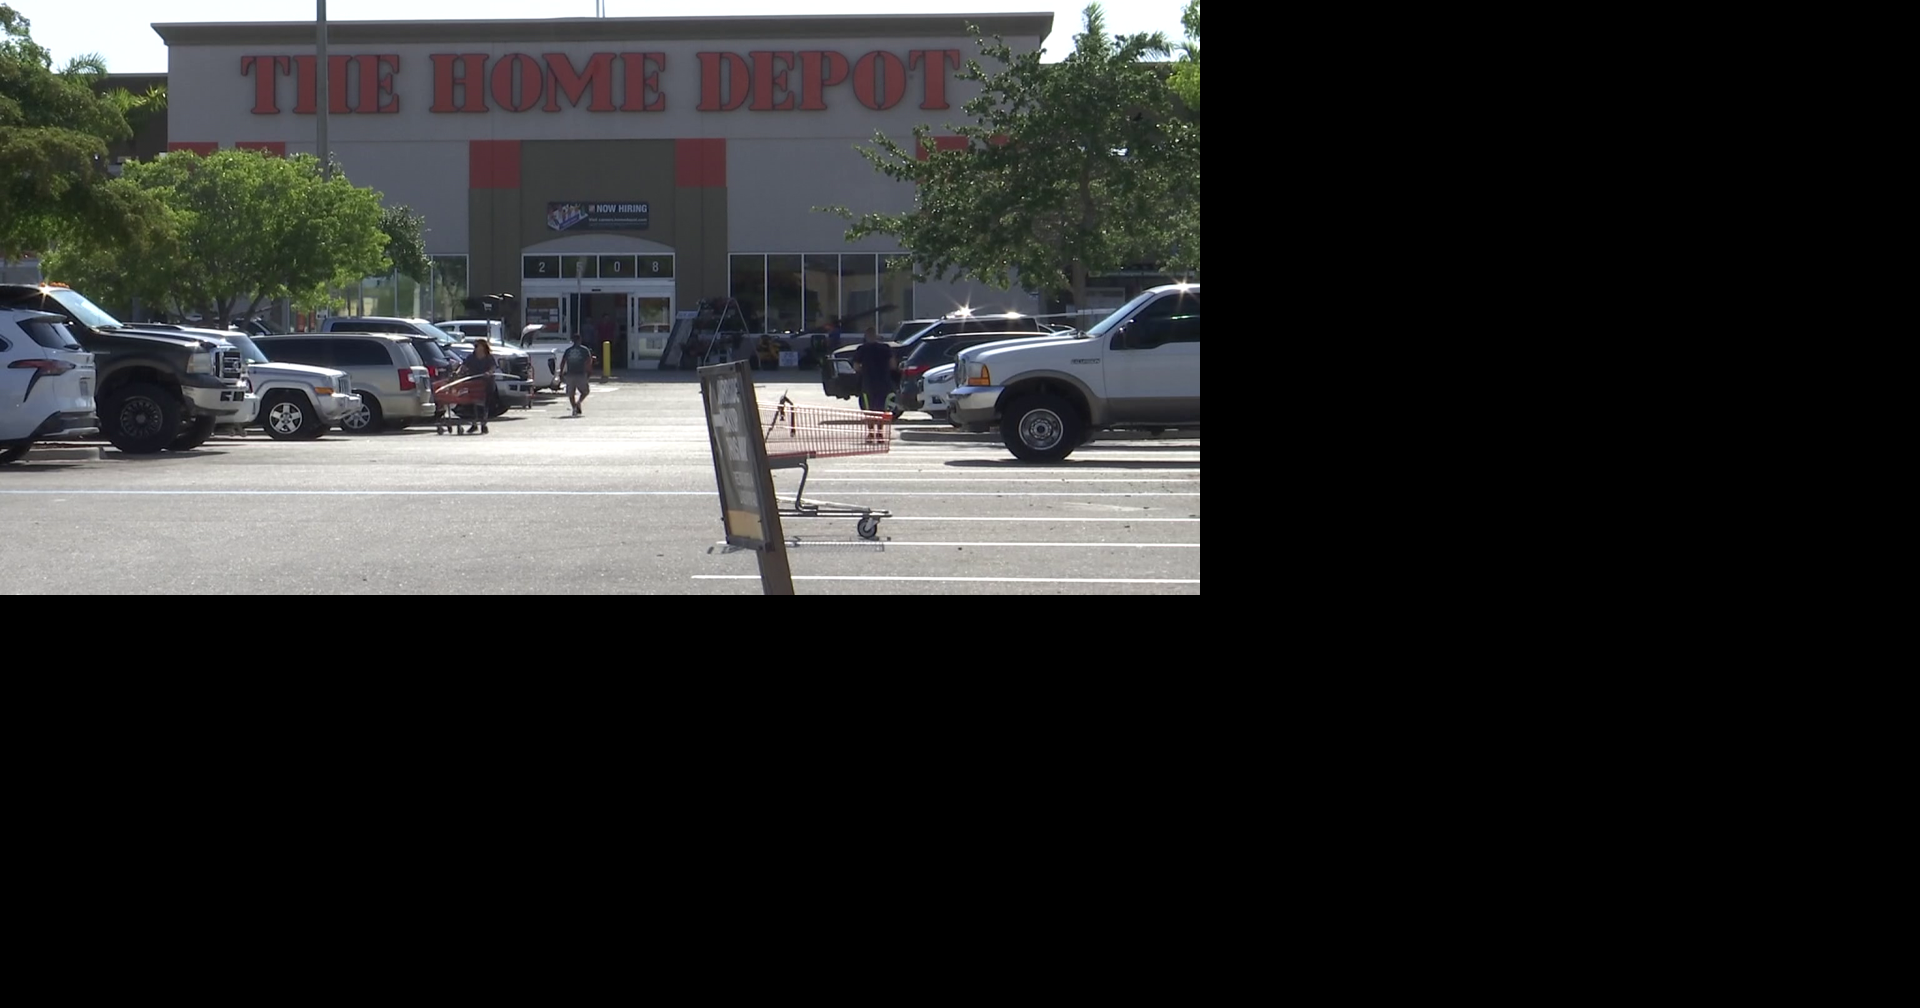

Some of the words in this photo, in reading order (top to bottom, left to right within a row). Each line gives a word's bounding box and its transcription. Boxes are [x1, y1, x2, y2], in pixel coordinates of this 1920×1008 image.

[240, 54, 400, 115] THE
[428, 52, 666, 113] HOME
[696, 49, 961, 112] DEPOT
[596, 204, 616, 213] NOW
[618, 204, 648, 213] HIRING
